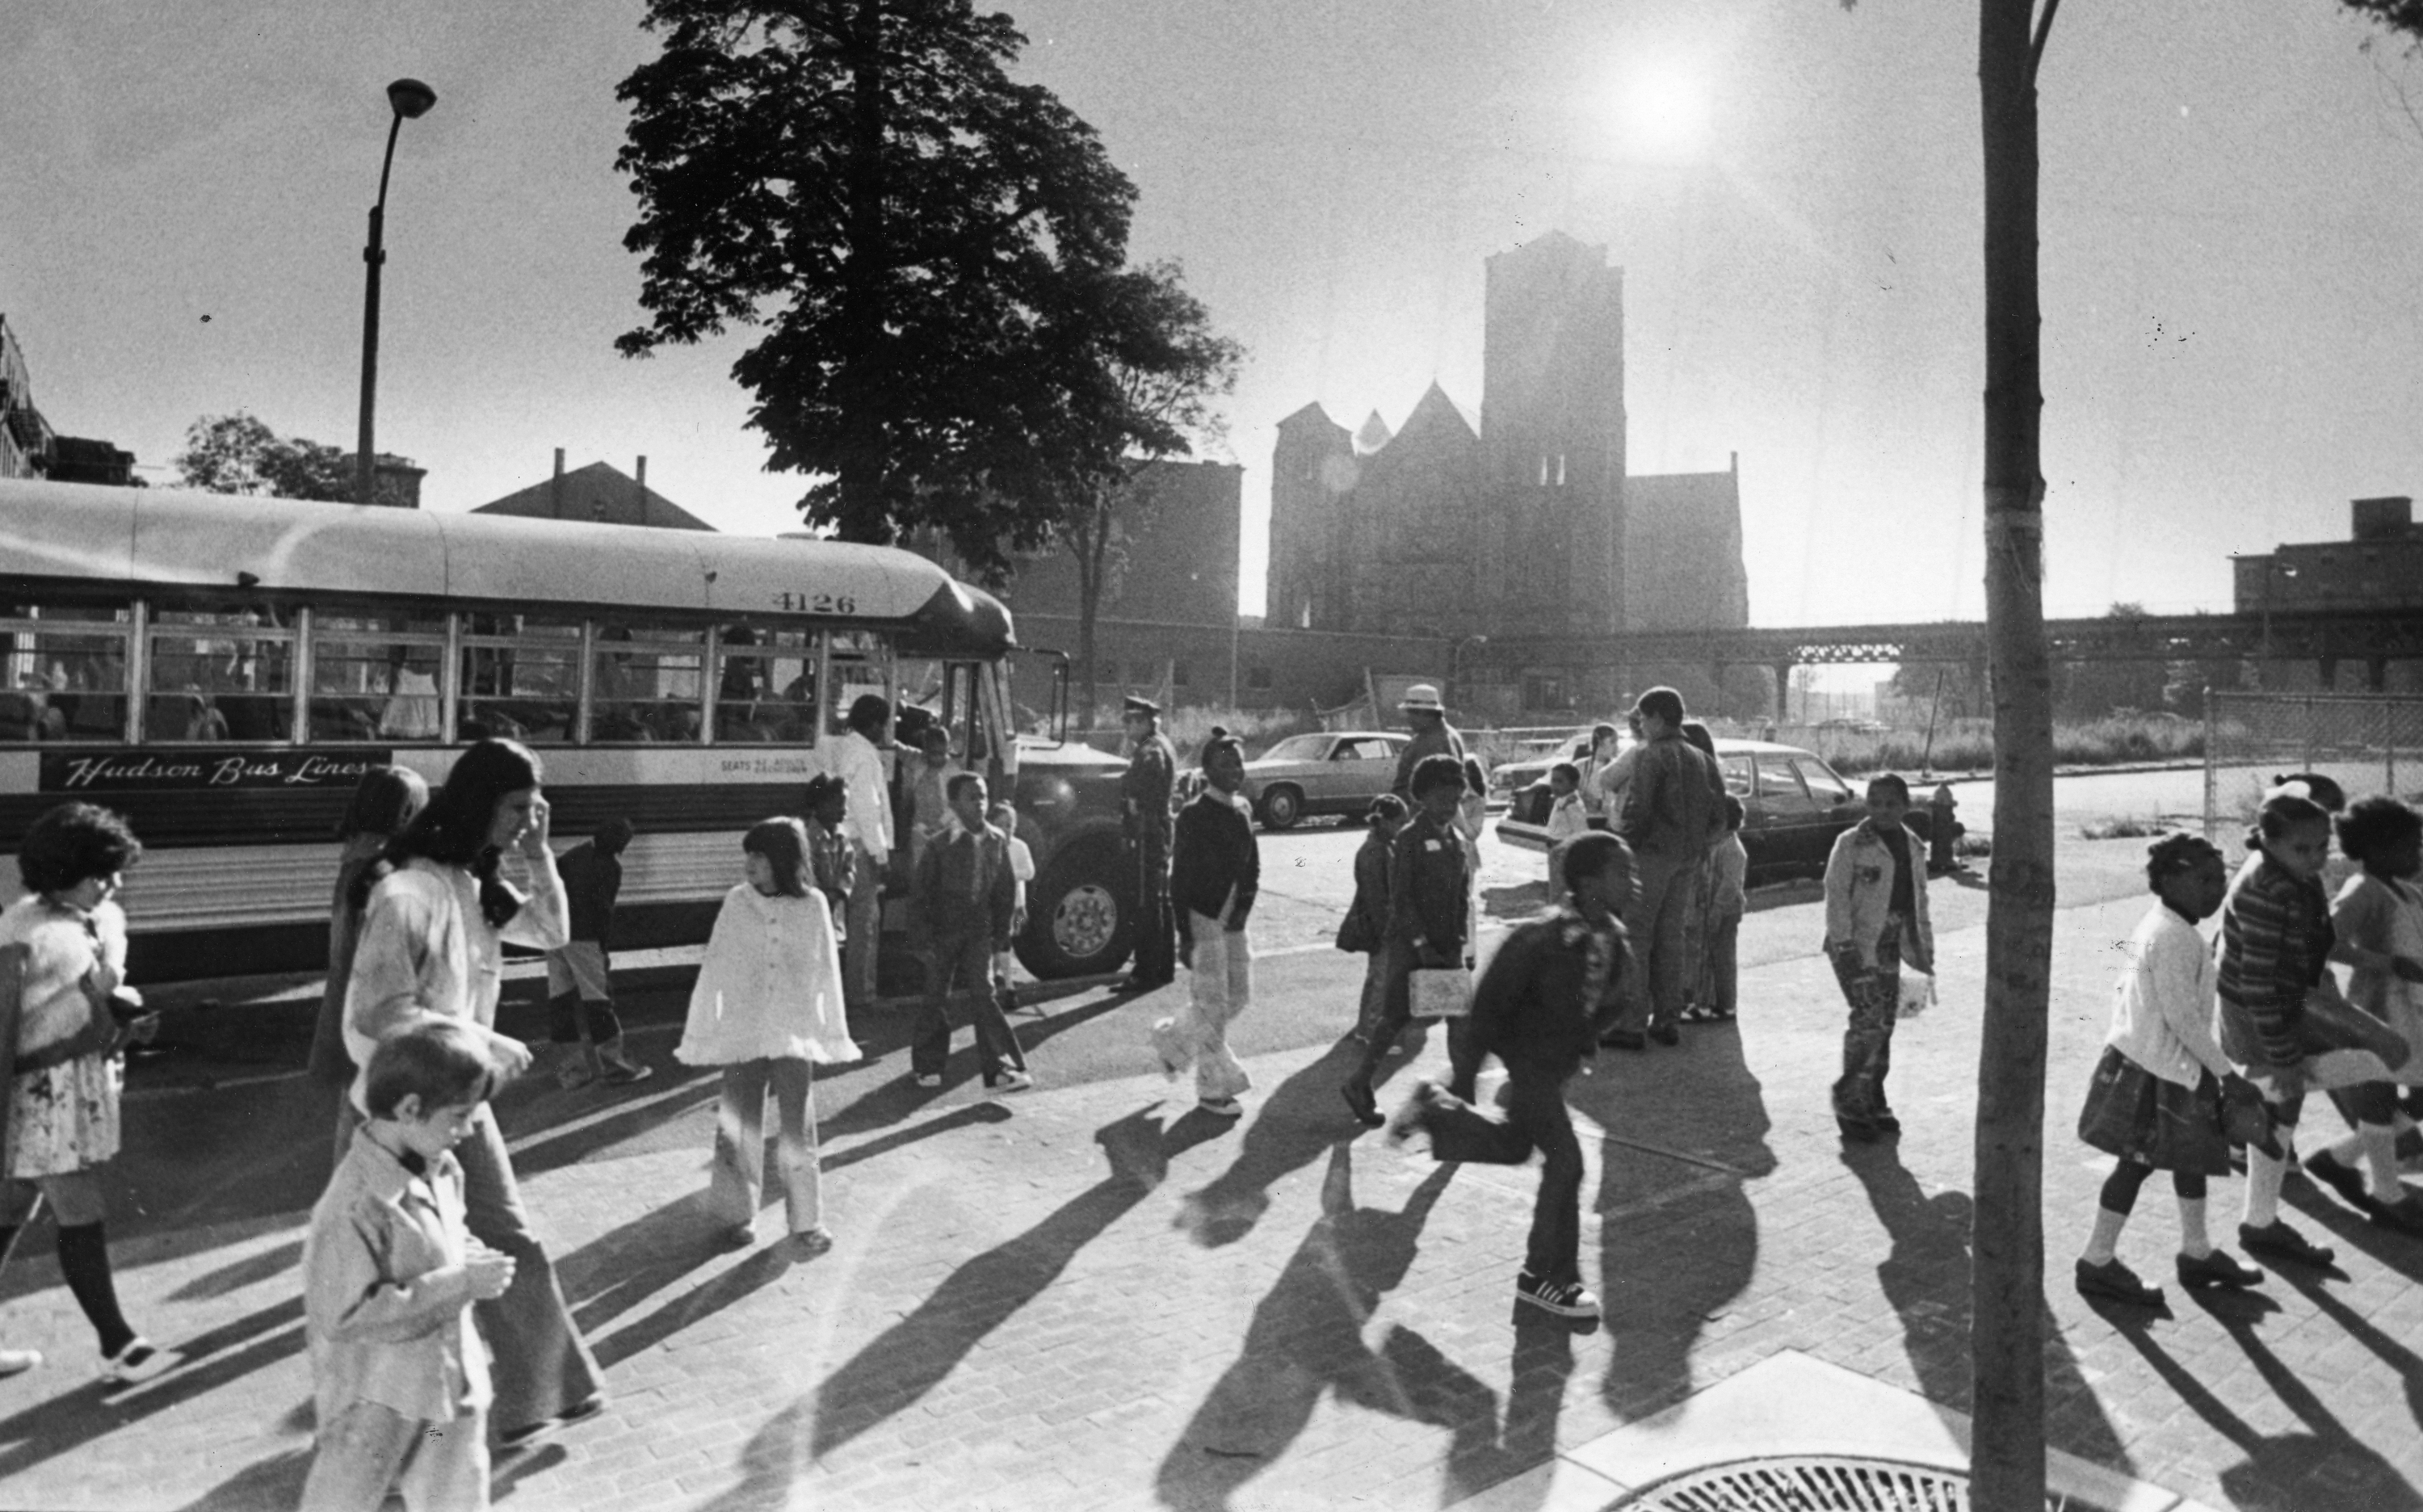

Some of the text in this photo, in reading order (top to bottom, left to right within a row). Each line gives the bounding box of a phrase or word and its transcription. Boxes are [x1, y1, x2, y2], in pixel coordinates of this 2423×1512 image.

[772, 592, 855, 614] 4126
[65, 756, 367, 787] Hudson Bus Lines
[720, 760, 751, 771] SEATS
